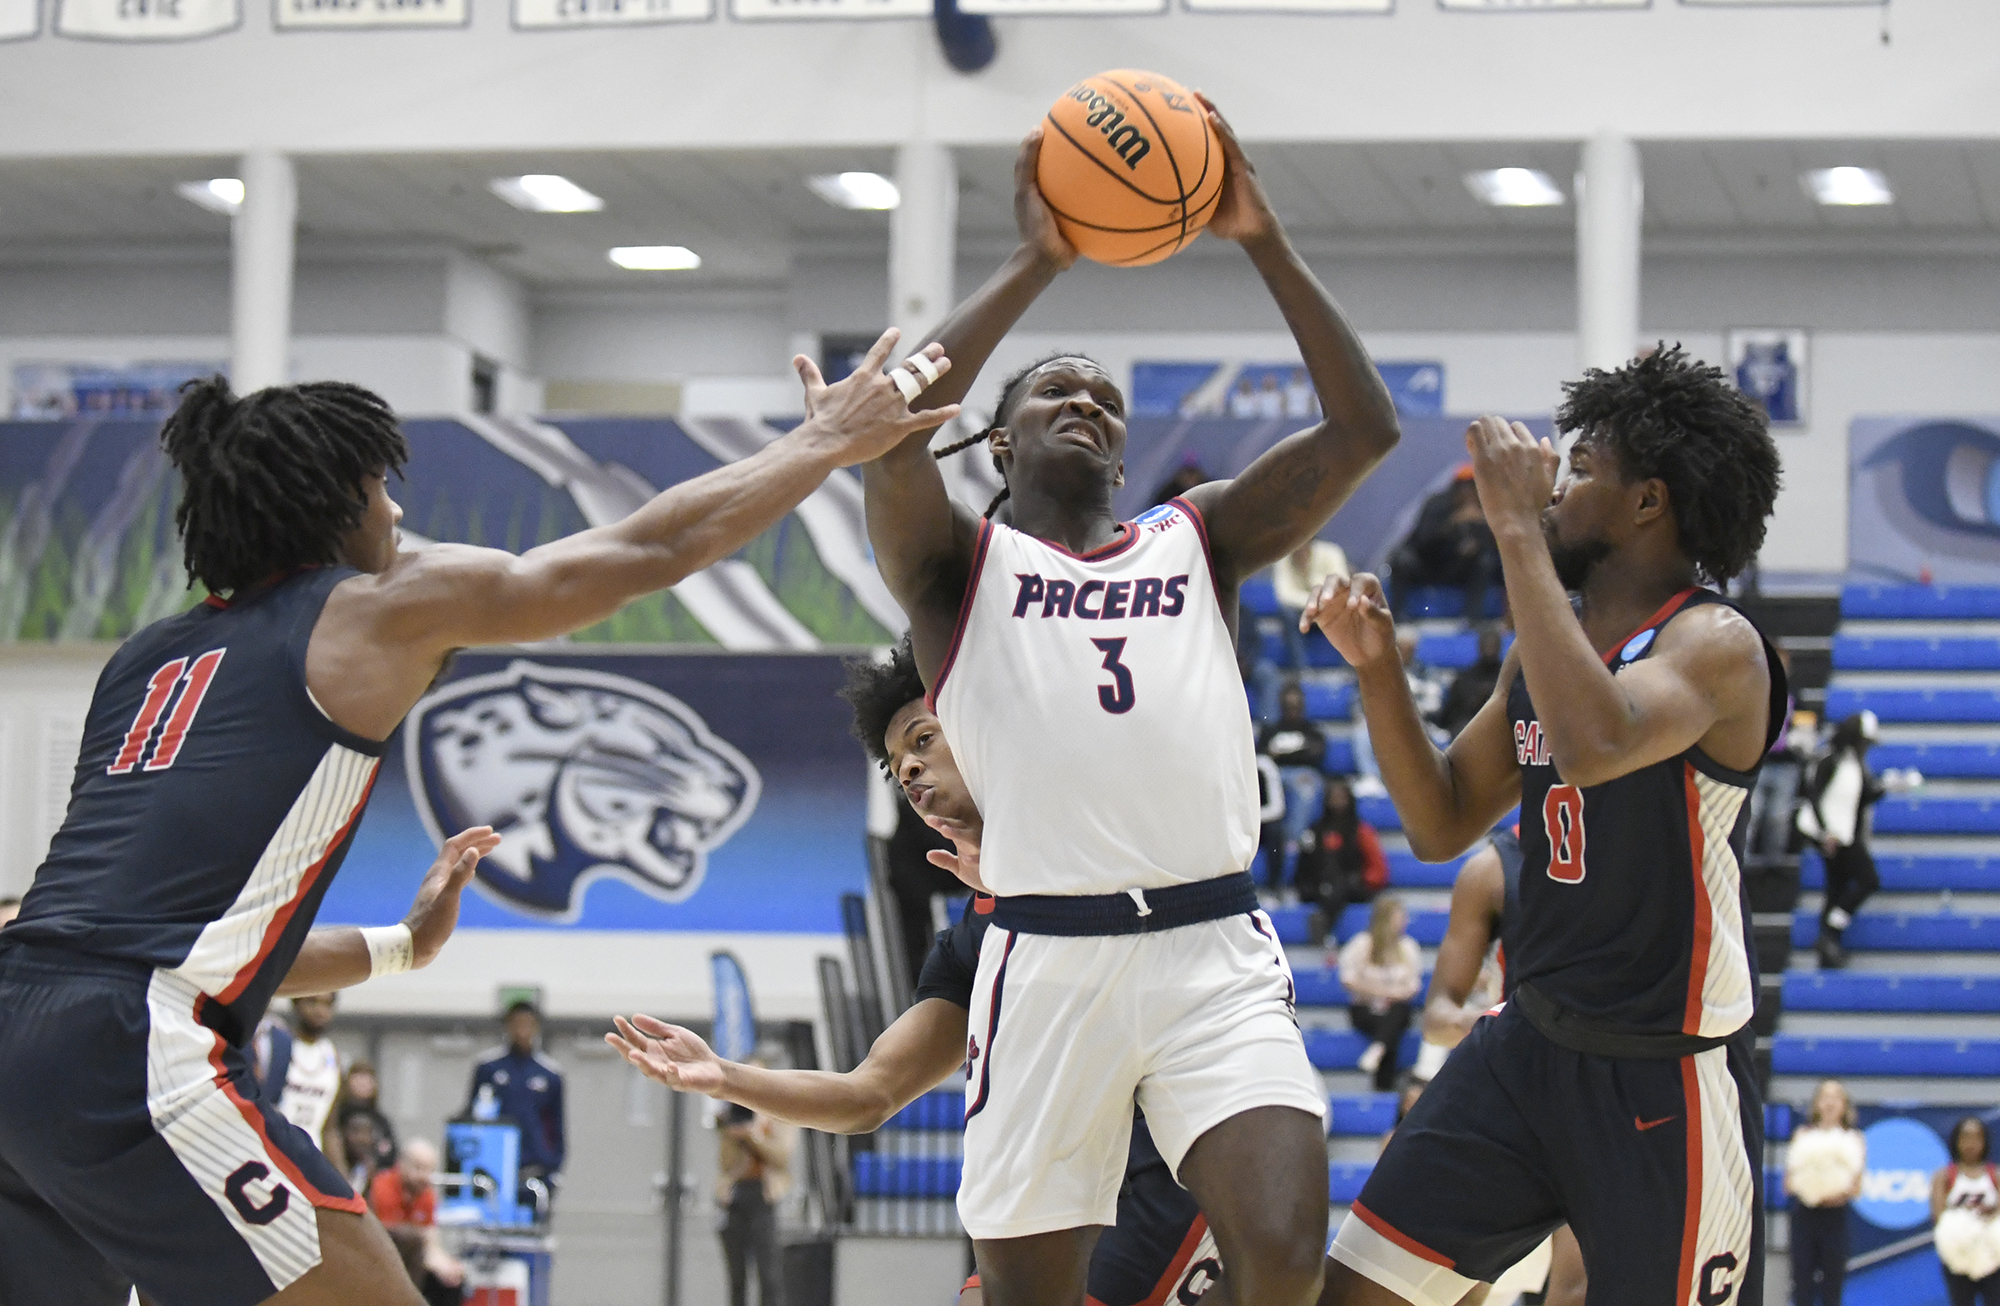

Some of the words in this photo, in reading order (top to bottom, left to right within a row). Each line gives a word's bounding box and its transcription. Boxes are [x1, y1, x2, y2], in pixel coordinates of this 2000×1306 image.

[1066, 83, 1151, 171] Wilson
[1012, 573, 1190, 620] PACERS
[107, 647, 228, 776] 11
[1090, 637, 1136, 715] 3
[1543, 784, 1587, 884] 0
[224, 1160, 291, 1226] C
[1862, 1169, 1930, 1203] NCA
[1696, 1252, 1738, 1306] C
